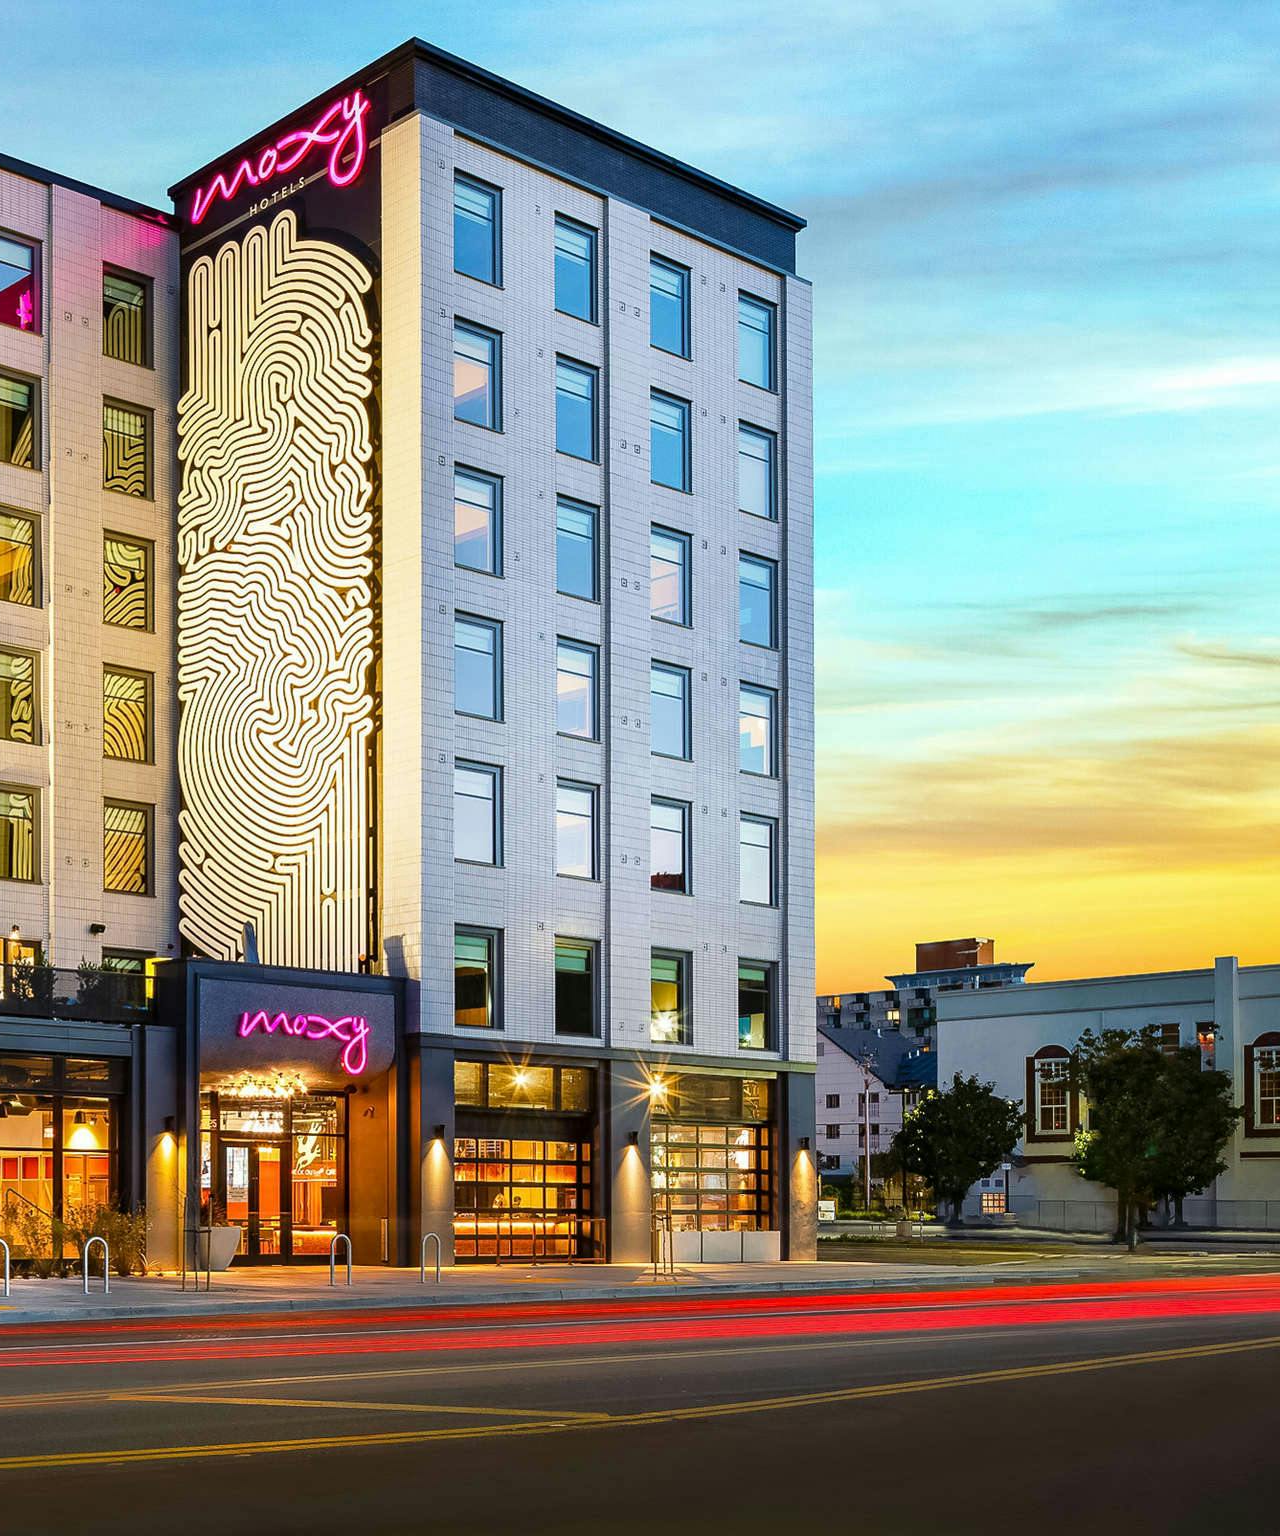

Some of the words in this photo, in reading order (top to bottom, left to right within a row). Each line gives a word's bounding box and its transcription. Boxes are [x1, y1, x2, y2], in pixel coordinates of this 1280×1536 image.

[191, 90, 370, 224] moxy
[249, 176, 306, 217] HOTELS
[239, 1010, 370, 1074] moxy
